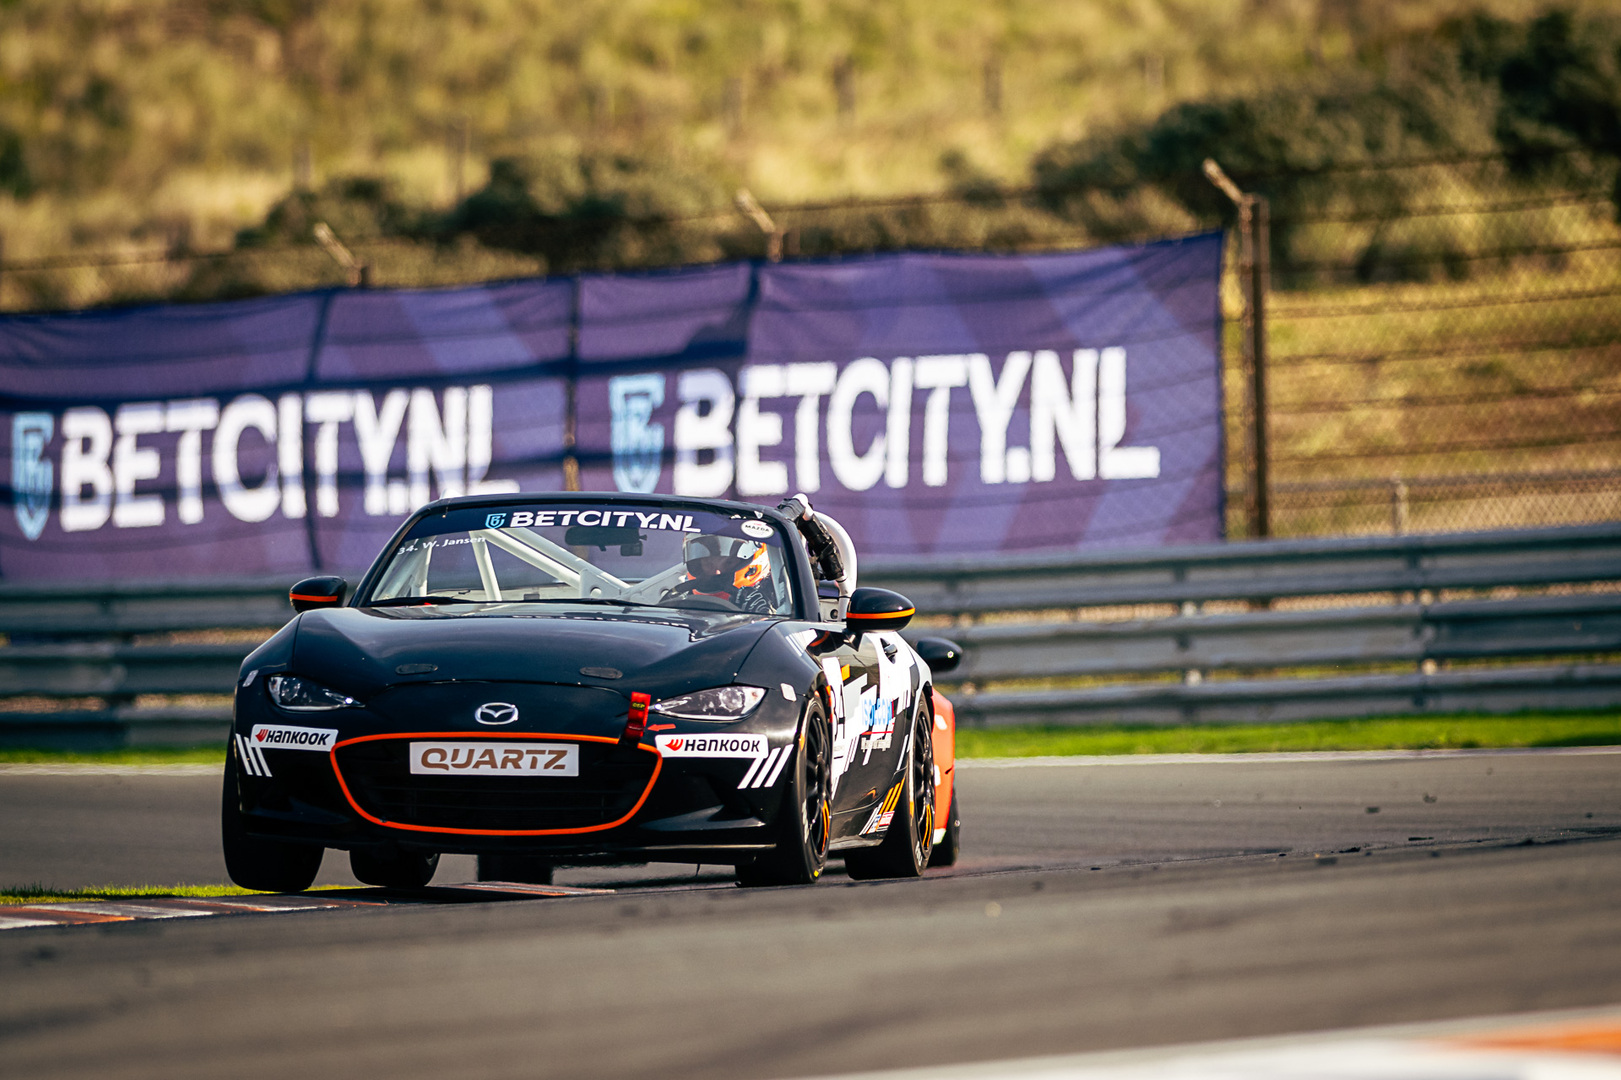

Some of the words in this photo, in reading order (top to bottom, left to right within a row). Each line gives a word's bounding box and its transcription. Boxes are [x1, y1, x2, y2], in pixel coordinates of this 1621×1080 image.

[674, 346, 1161, 498] BETCITY.NL
[59, 384, 520, 532] BETCITY.NL
[510, 510, 701, 533] BETCITY.NL
[745, 524, 770, 532] MAZDA
[422, 540, 440, 549] W.
[441, 537, 486, 548] Jansen
[421, 747, 568, 771] QUARTZ
